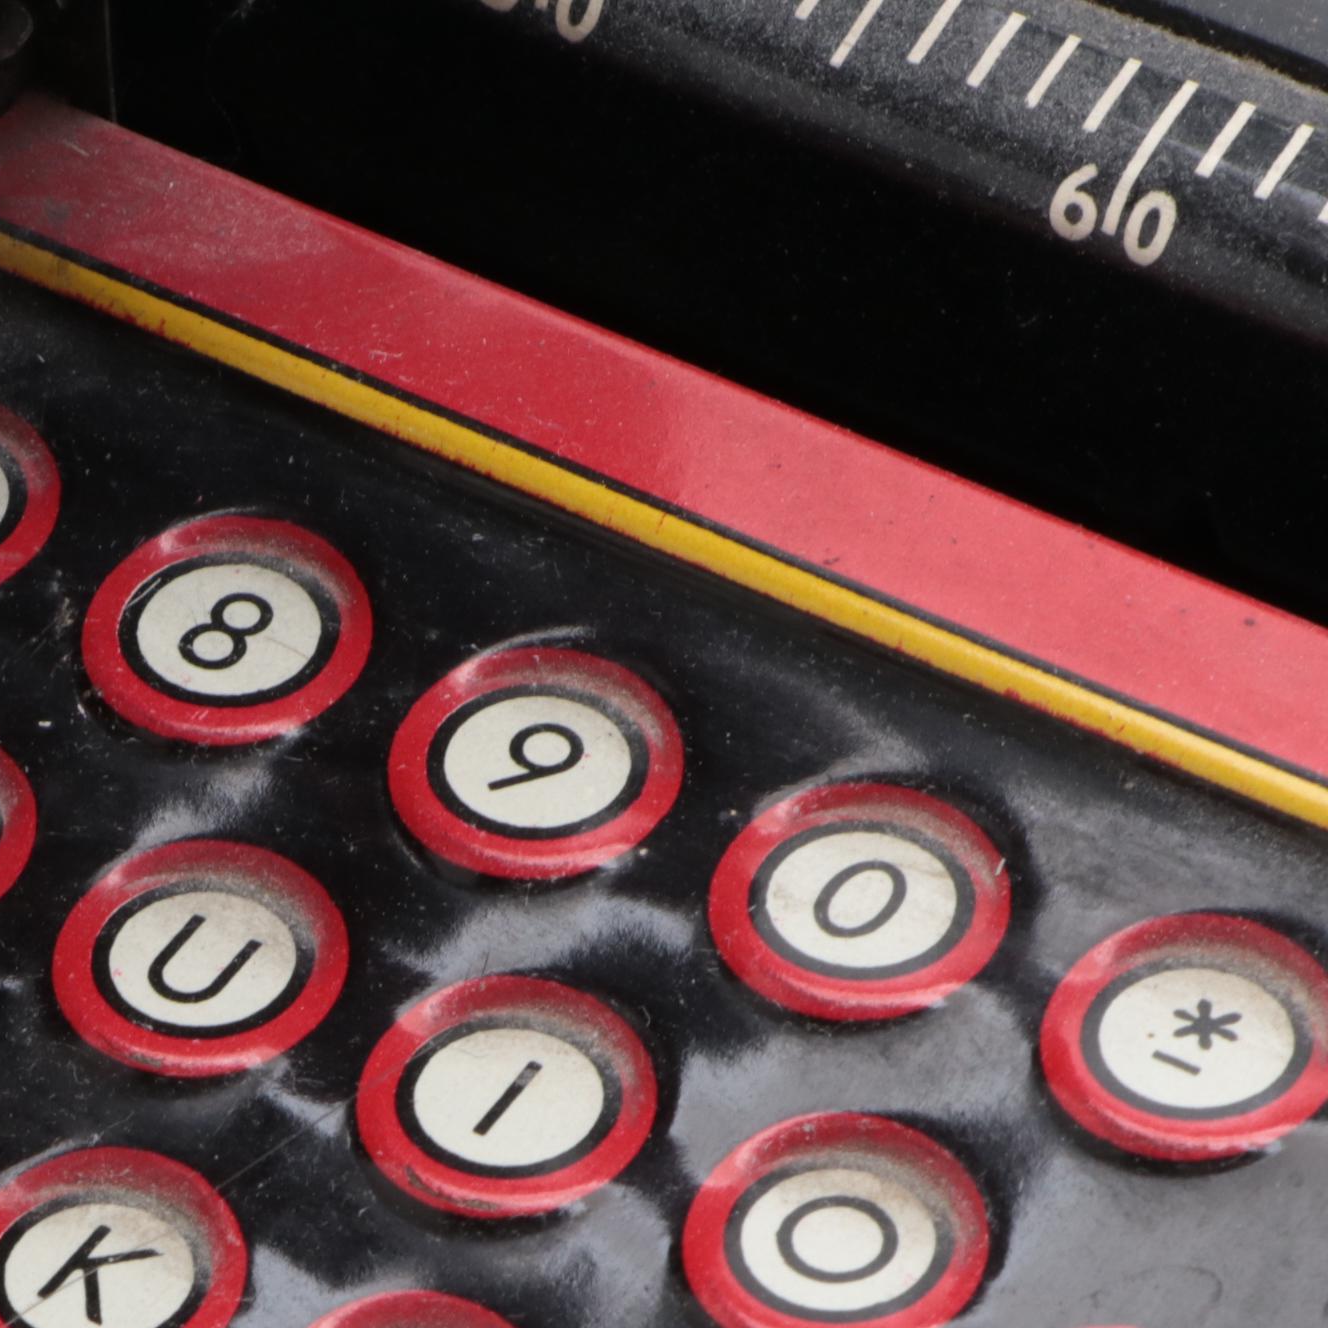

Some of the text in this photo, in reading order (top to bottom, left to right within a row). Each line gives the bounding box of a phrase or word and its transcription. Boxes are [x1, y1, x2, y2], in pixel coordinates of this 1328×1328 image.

[1050, 164, 1176, 267] 60
[179, 591, 274, 671] 8
[488, 722, 585, 791] 9
[147, 914, 262, 1004] U
[472, 1060, 543, 1136] I
[38, 1224, 164, 1326] K
[777, 1195, 899, 1284] O
